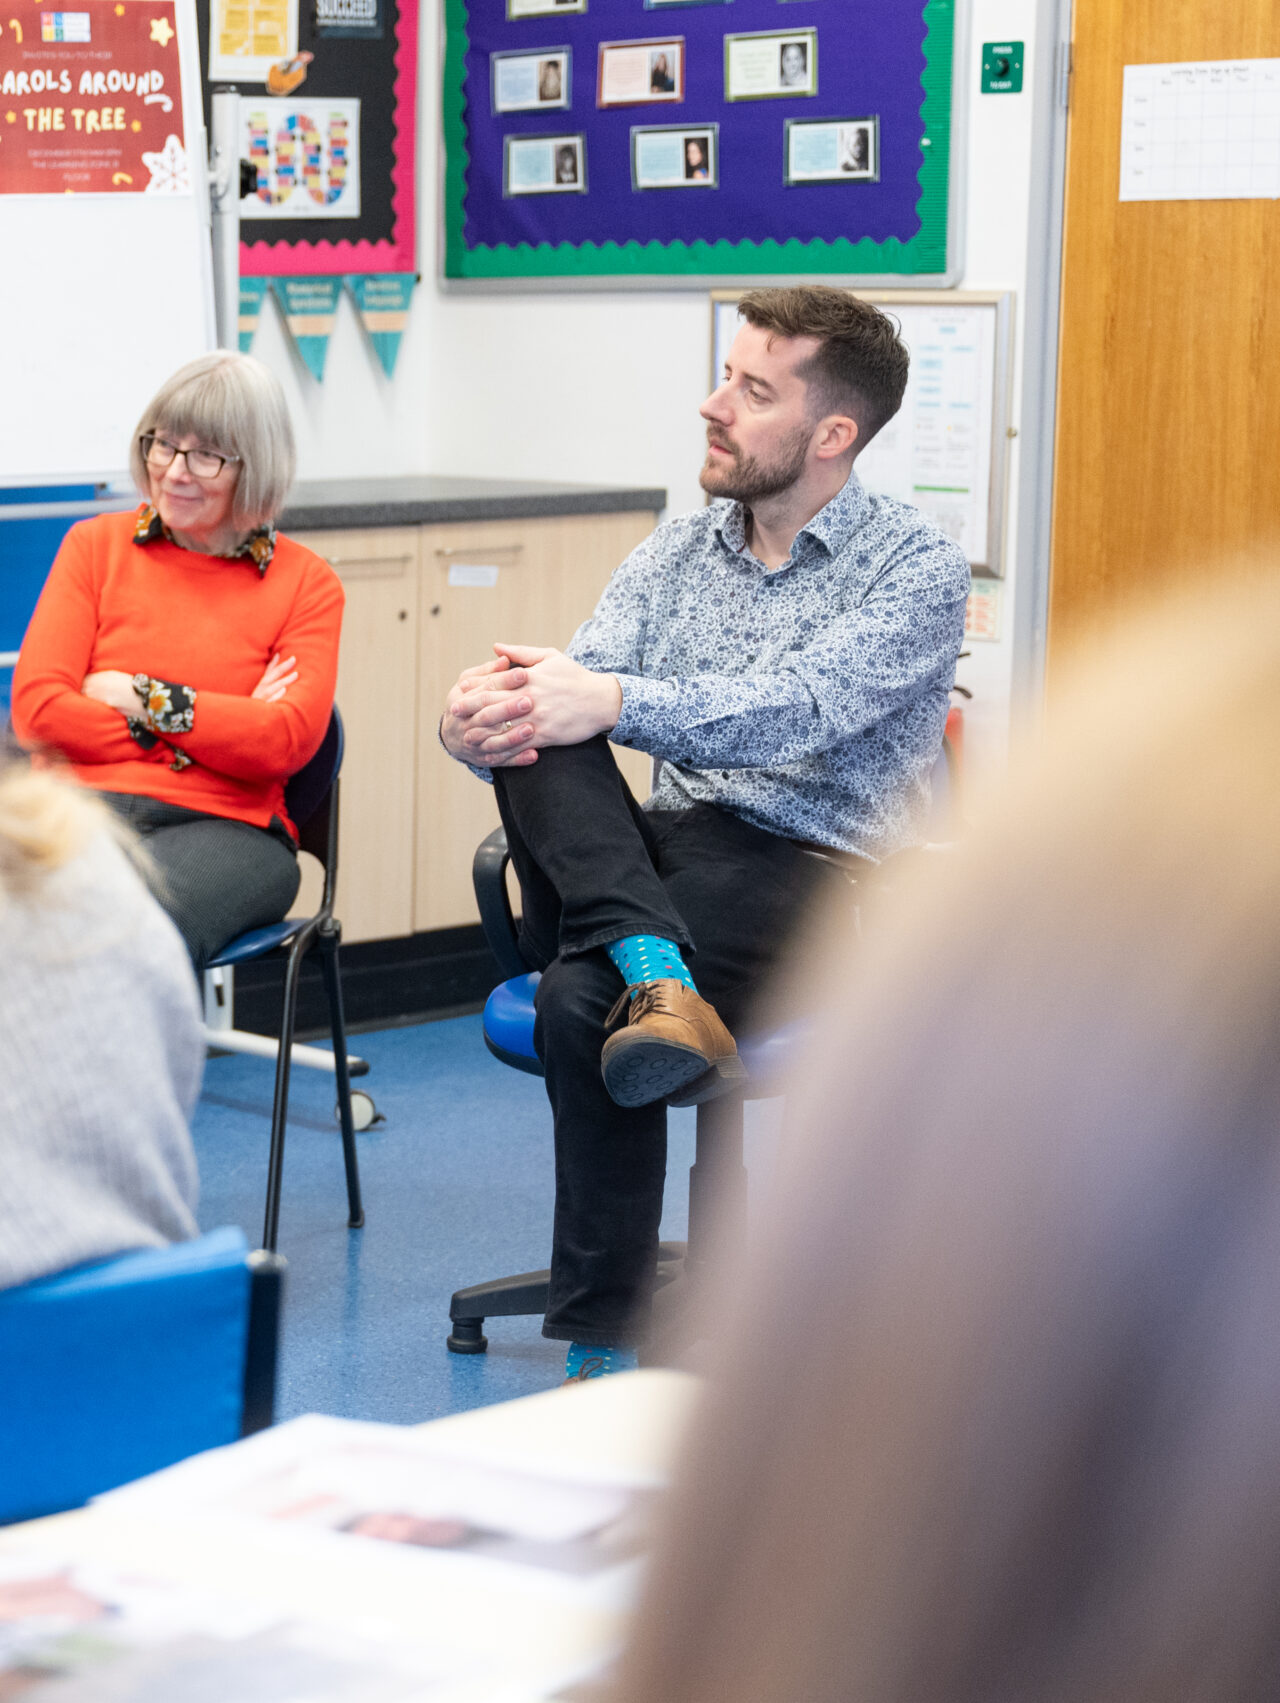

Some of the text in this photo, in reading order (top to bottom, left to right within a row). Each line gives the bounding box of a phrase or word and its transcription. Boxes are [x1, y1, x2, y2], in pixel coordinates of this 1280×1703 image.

[992, 46, 1013, 55] PRESS
[79, 69, 164, 96] AROUND
[22, 107, 126, 134] THE TREE
